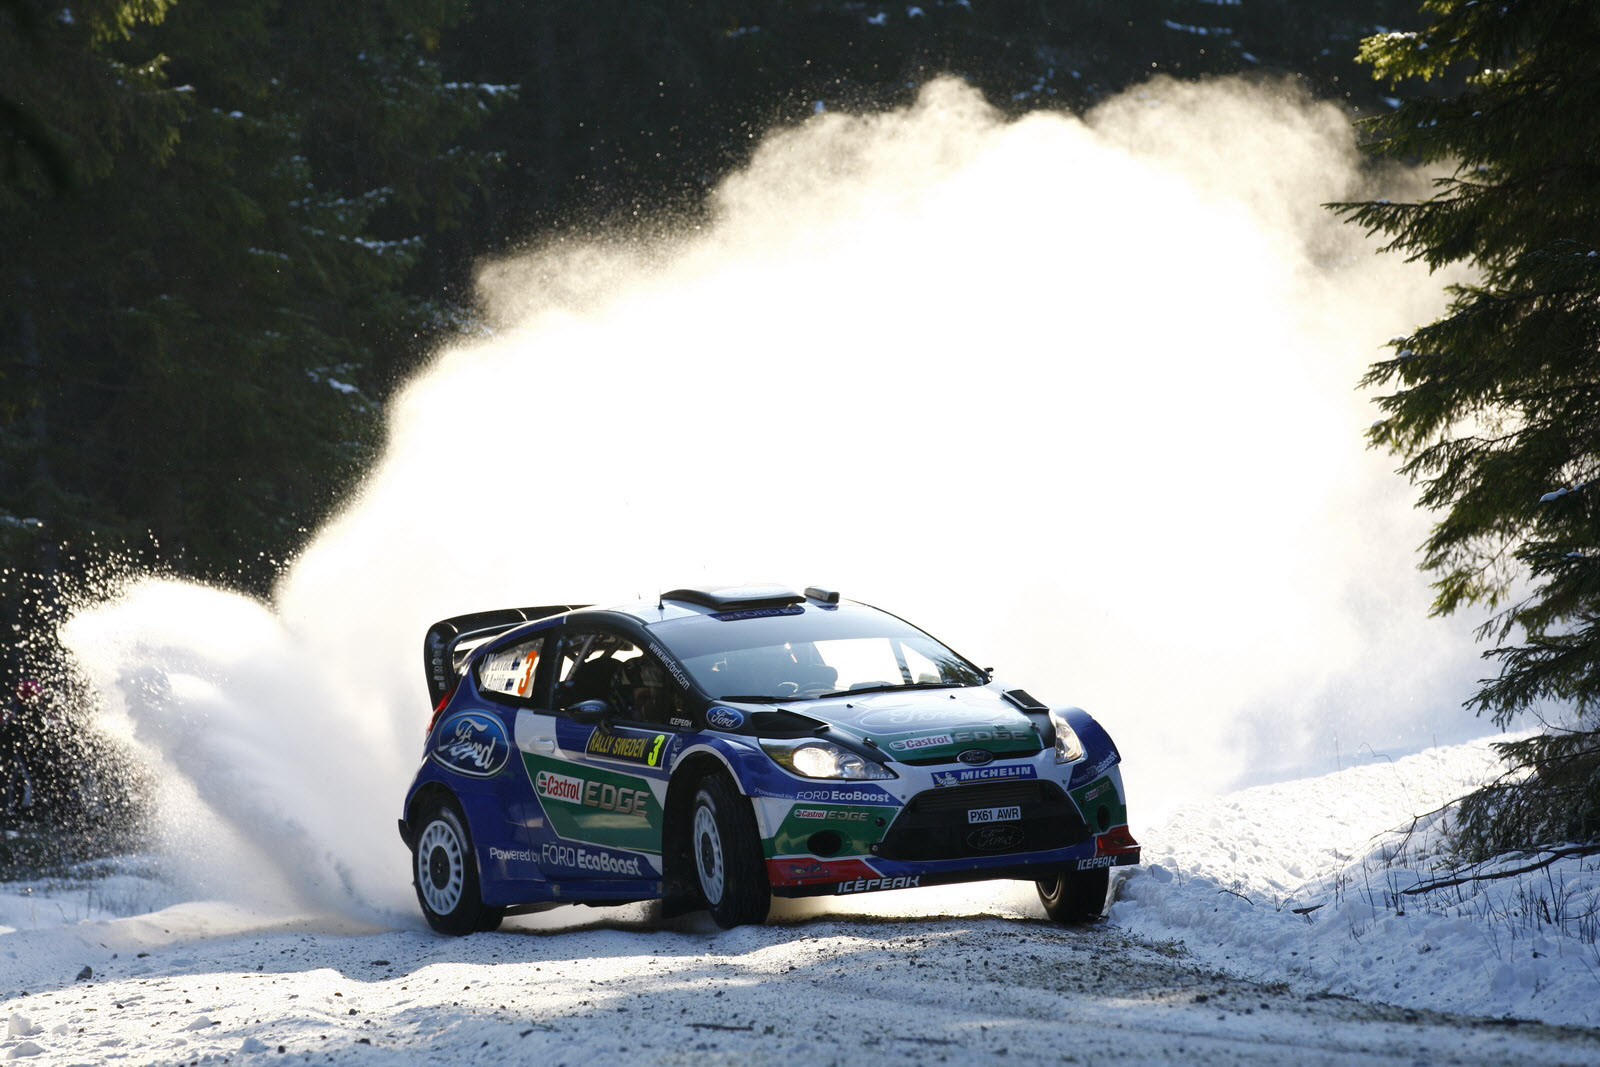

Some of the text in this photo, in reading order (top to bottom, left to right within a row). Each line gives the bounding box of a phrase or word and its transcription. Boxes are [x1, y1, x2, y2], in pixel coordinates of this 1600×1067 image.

[518, 650, 538, 695] 3
[649, 641, 690, 690] www.wrcford.com
[713, 709, 738, 728] Ford
[438, 717, 497, 769] Ford
[905, 730, 1029, 748] Castrol EDGE
[589, 731, 616, 752] RALLY
[613, 737, 648, 758] SWEDEN
[647, 734, 665, 766] 3
[960, 767, 1031, 780] MICHELIN
[547, 775, 650, 817] Castrol EDGE
[796, 791, 830, 800] FORD
[831, 790, 889, 802] EcoBoost
[801, 810, 869, 821] Castrol EDGE
[970, 809, 1019, 822] PX61 AWR
[490, 847, 530, 862] Powered
[542, 844, 576, 867] FORD
[577, 849, 642, 876] EcoBoost
[1077, 856, 1117, 871] ICEPEAK
[837, 875, 920, 893] ICEPEAK
